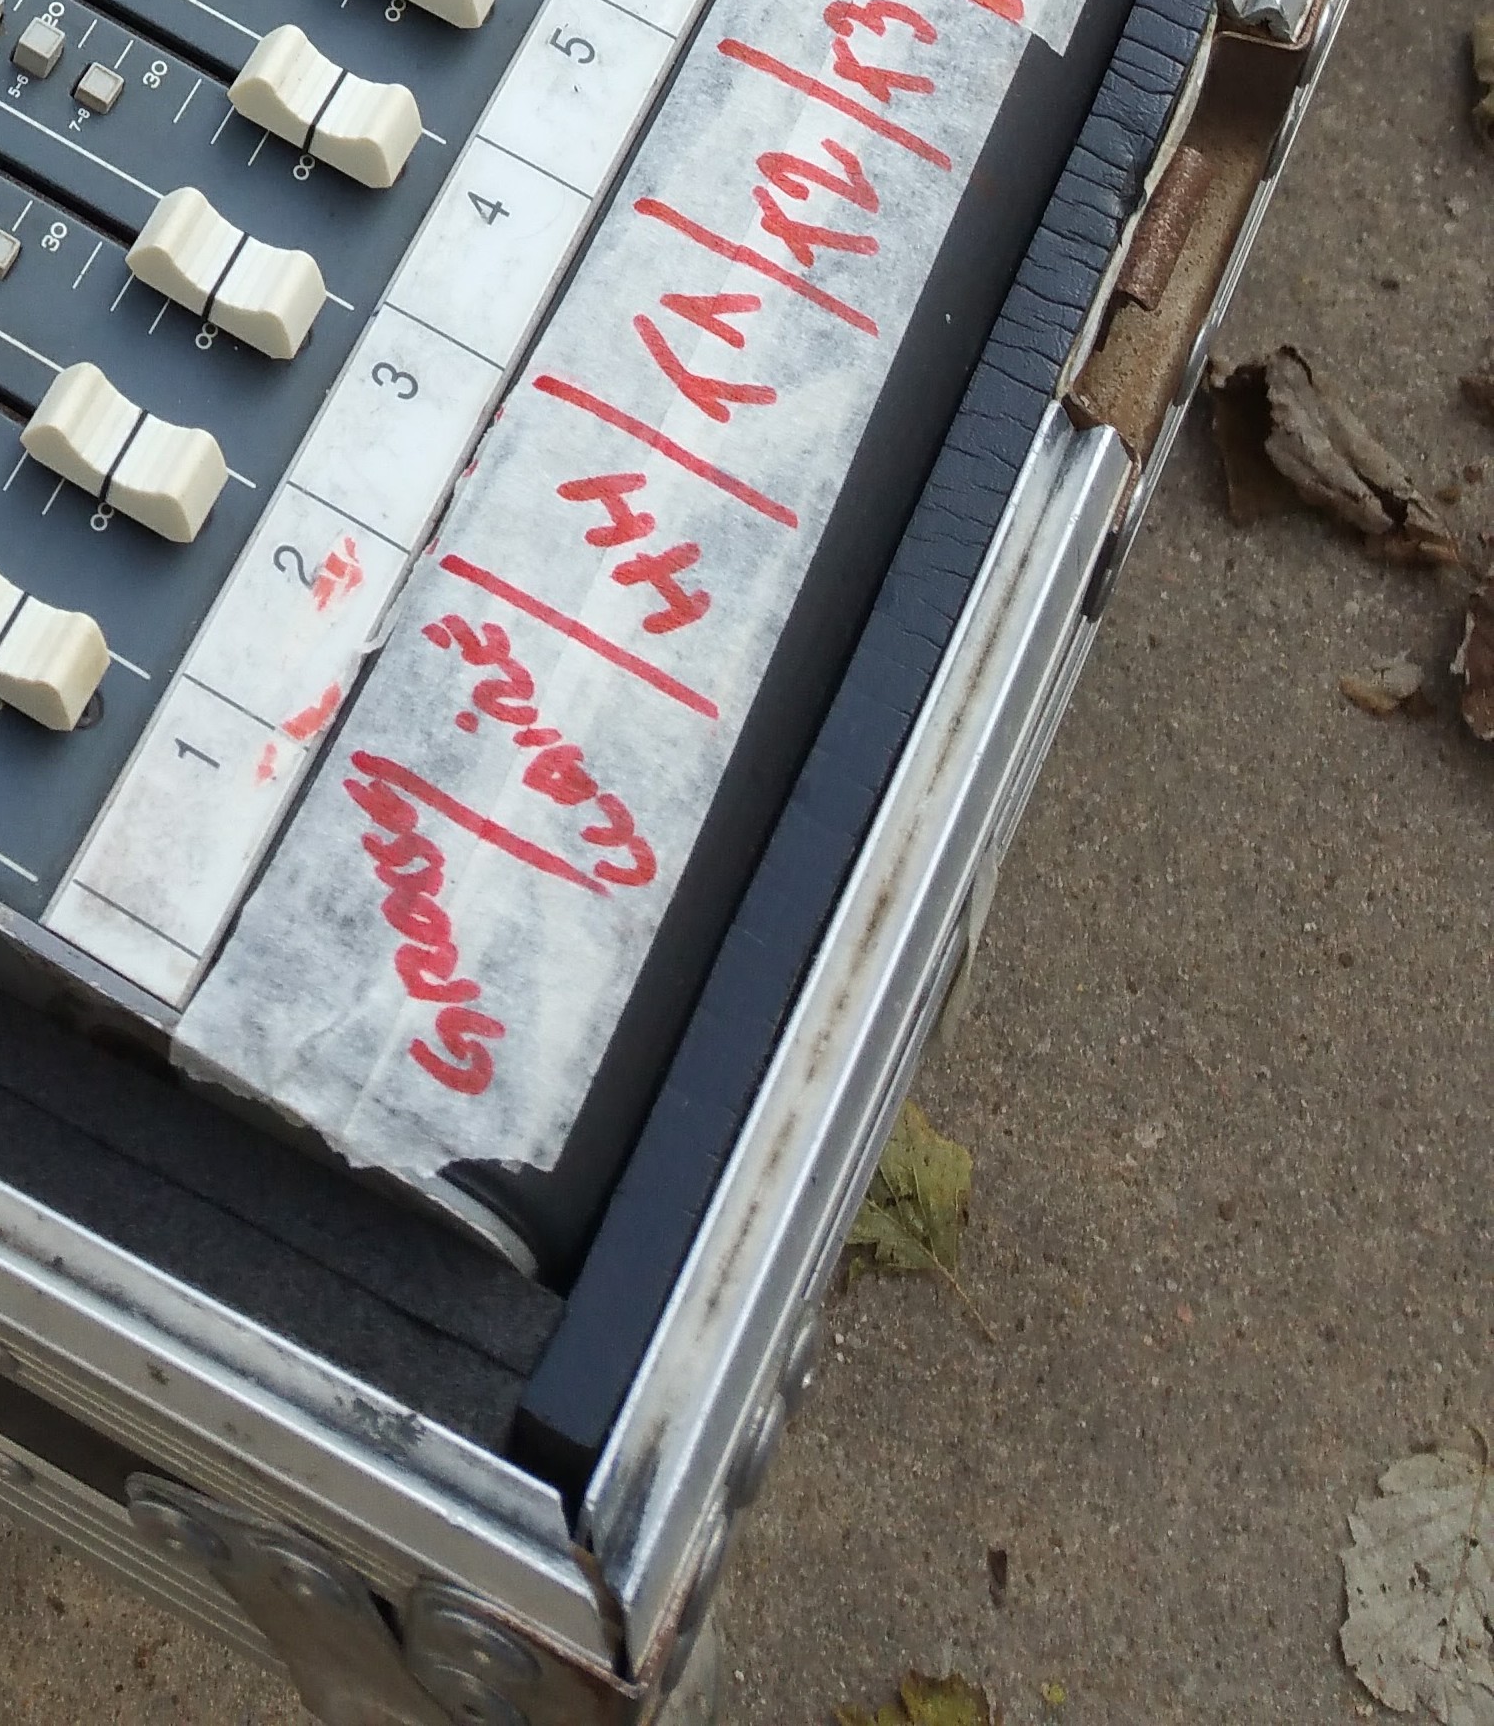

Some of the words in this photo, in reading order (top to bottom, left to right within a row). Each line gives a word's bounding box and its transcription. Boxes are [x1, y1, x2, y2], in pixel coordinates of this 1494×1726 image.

[550, 25, 596, 65] 5
[143, 61, 168, 90] 30
[68, 107, 92, 134] 7-8
[466, 191, 510, 225] 4
[40, 221, 69, 253] 30
[370, 360, 419, 400] 3
[274, 543, 316, 591] 2
[556, 472, 712, 635] HH
[177, 735, 225, 771] 1
